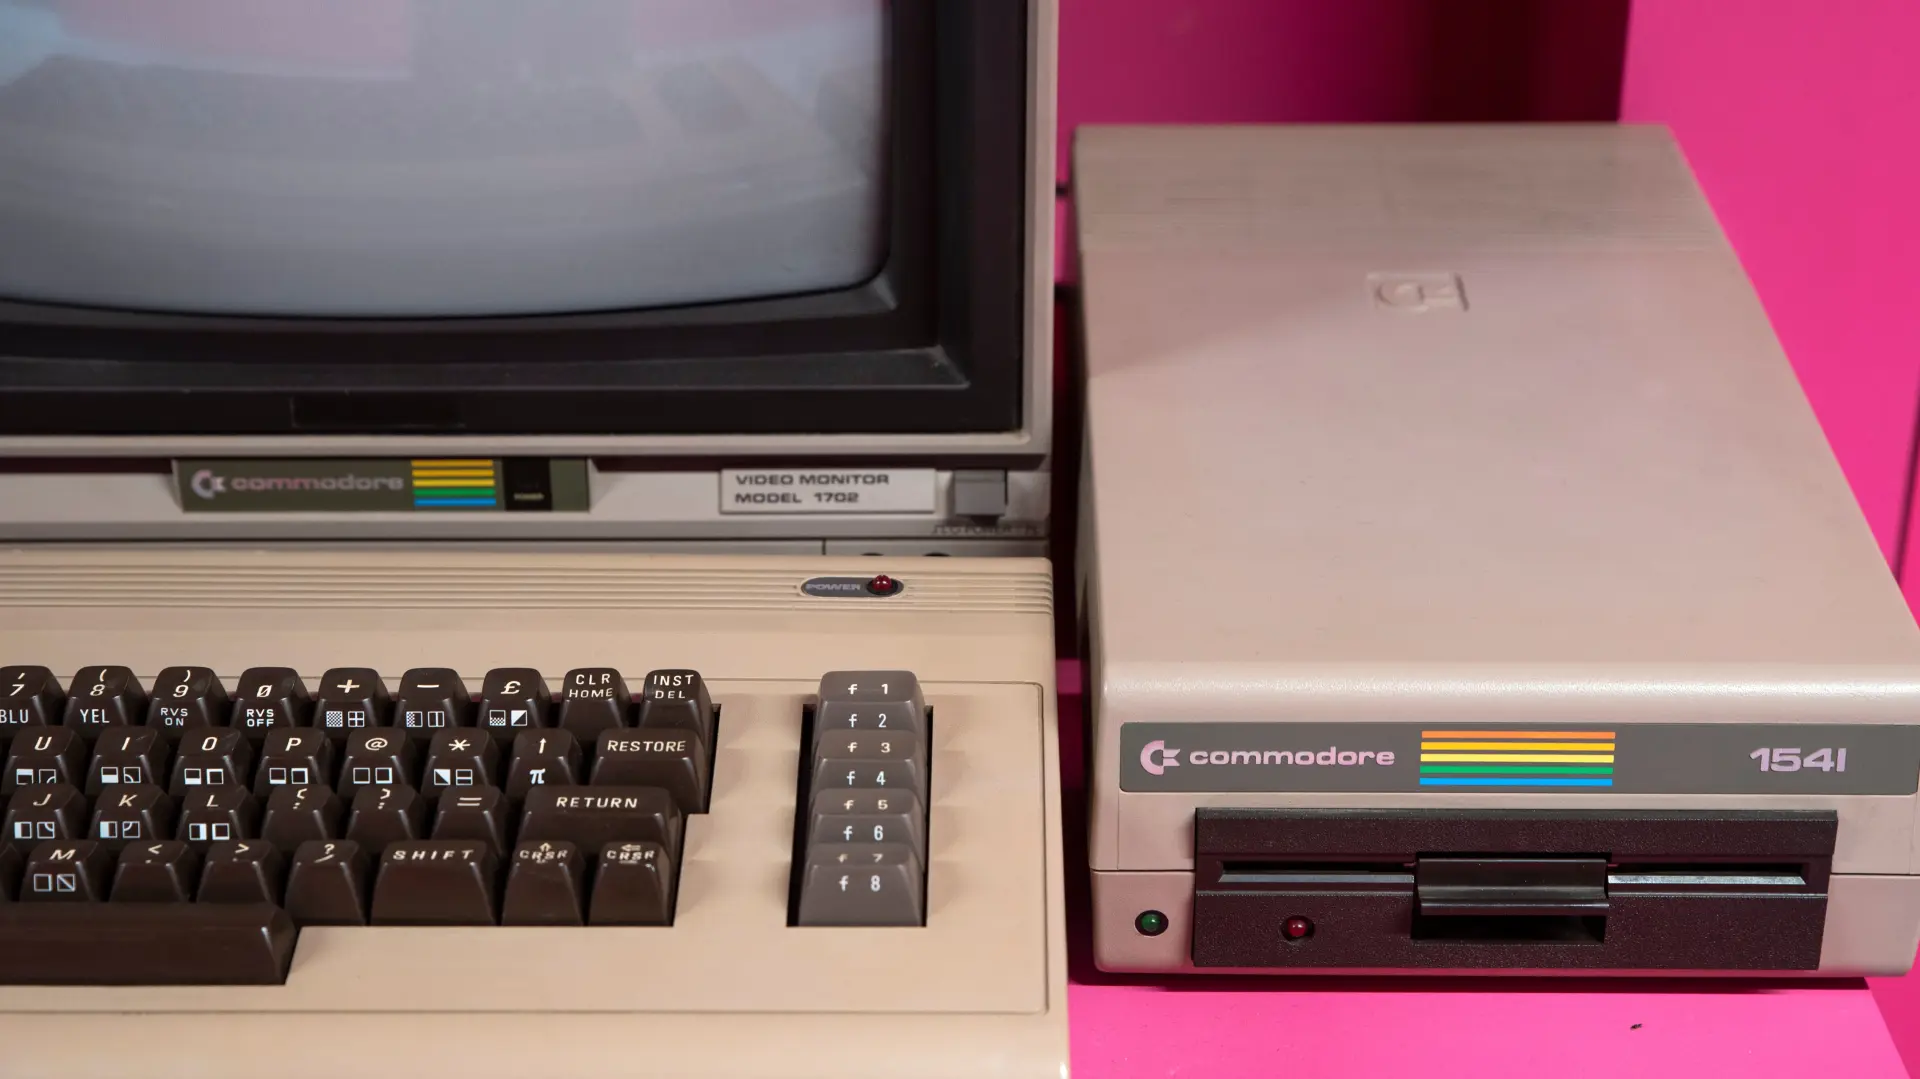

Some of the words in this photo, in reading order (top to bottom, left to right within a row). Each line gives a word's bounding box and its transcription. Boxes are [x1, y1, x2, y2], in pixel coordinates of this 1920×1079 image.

[230, 473, 405, 491] commodore
[735, 474, 794, 486] VIDEO
[798, 473, 889, 485] MONITOR
[734, 492, 802, 504] MODEL
[813, 491, 859, 504] 1702
[804, 583, 861, 591] POWER
[575, 673, 611, 686] CLR
[653, 674, 694, 687] INST
[10, 683, 25, 697] 7
[89, 683, 106, 697] 8
[172, 684, 189, 698] 9
[336, 679, 360, 694] +
[500, 680, 521, 695] £
[881, 683, 889, 695] 1
[568, 687, 613, 700] HOME
[654, 689, 686, 699] DEL
[0, 708, 29, 724] BLU
[79, 708, 110, 724] YEL
[160, 707, 189, 717] RVS
[246, 708, 275, 718] RVS
[164, 717, 184, 727] ON
[246, 718, 275, 728] OFF
[878, 713, 887, 728] 2
[34, 736, 53, 751] U
[121, 736, 131, 751] I
[201, 736, 218, 751] O
[285, 737, 302, 752] P
[364, 737, 389, 751] @
[607, 739, 686, 752] RESTORE
[880, 742, 891, 753] 3
[1189, 745, 1395, 766] commodore
[1749, 747, 1847, 772] 1541
[529, 768, 546, 785] π
[876, 770, 886, 786] 4
[32, 793, 52, 806] J
[118, 794, 138, 807] K
[206, 794, 219, 807] L
[556, 796, 638, 809] RETURN
[877, 799, 889, 810] 5
[873, 824, 884, 841] 6
[49, 849, 76, 861] M
[324, 843, 335, 855] ?
[392, 849, 473, 861] SHIFT
[519, 849, 568, 862] CRSR
[606, 849, 655, 862] CRSR
[873, 853, 884, 863] 7
[870, 874, 881, 892] 8
